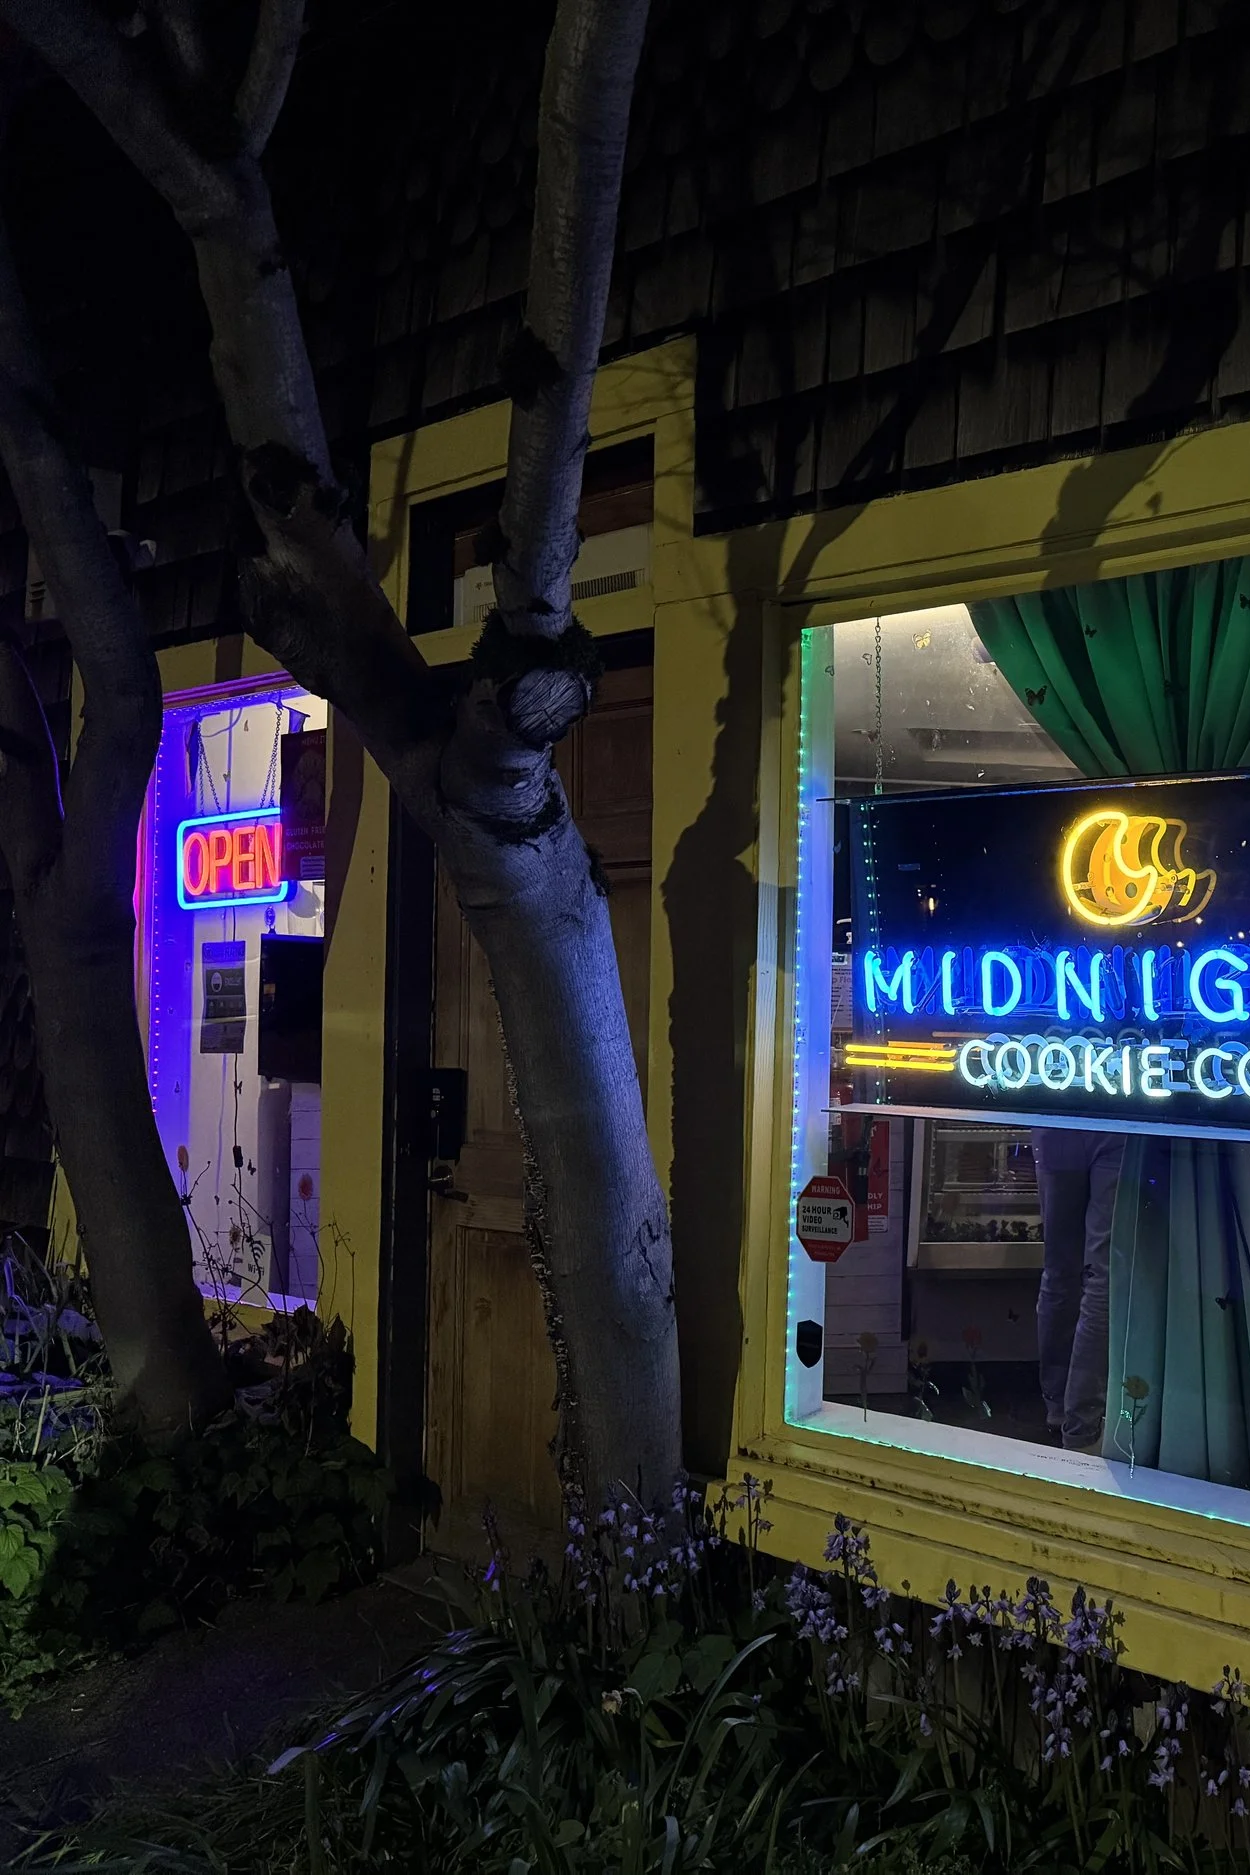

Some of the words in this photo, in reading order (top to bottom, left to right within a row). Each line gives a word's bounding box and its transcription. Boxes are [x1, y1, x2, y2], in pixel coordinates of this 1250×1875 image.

[184, 823, 282, 895] OPEN
[960, 1038, 1172, 1098] COOKIE
[811, 1185, 840, 1195] WARNING
[802, 1206, 812, 1214] 24
[812, 1206, 832, 1215] HOUR
[802, 1215, 822, 1224] VIDEO
[802, 1225, 837, 1235] SURVEILLANCE
